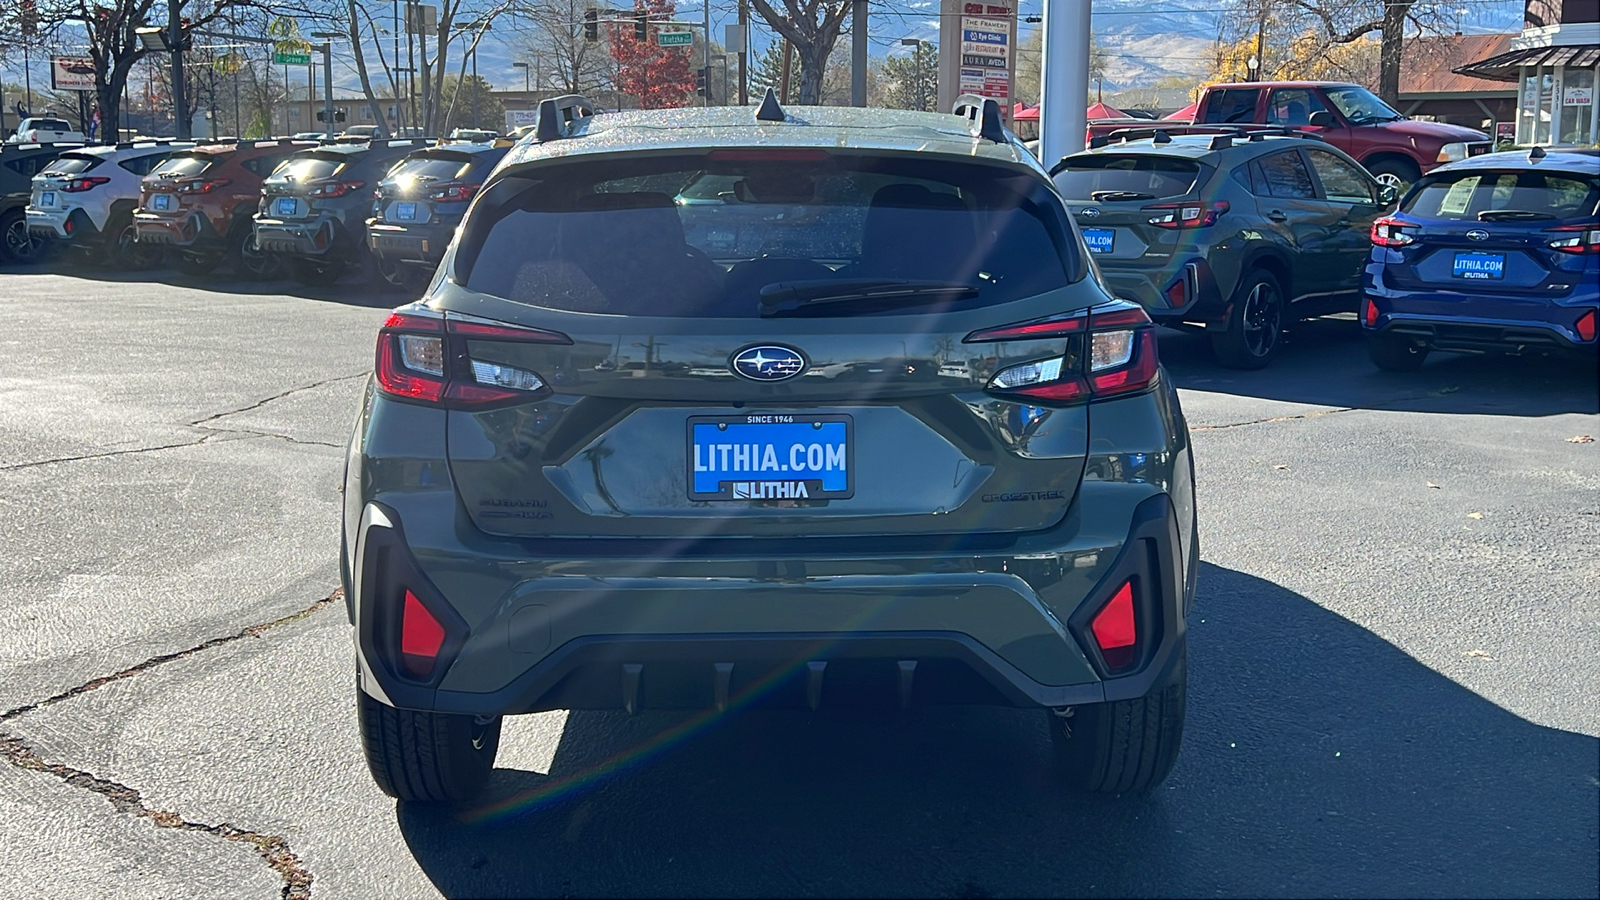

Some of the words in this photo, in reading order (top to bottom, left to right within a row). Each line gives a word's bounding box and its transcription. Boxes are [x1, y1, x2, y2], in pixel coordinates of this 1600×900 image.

[966, 18, 978, 26] THE
[980, 21, 1008, 29] FRAMERY
[978, 32, 987, 41] Eye
[988, 33, 1001, 42] Clinic
[975, 44, 1000, 54] RESTAURANT
[964, 56, 985, 65] AURA
[988, 58, 1005, 67] AVEDA
[1453, 259, 1503, 271] LITHIA.COM
[747, 415, 772, 424] SINCE
[774, 415, 794, 423] 1946
[694, 443, 846, 472] LITHIA.COM
[750, 481, 809, 499] LITHIA
[981, 490, 1066, 503] CROSSTREK
[479, 499, 547, 508] SUBARU
